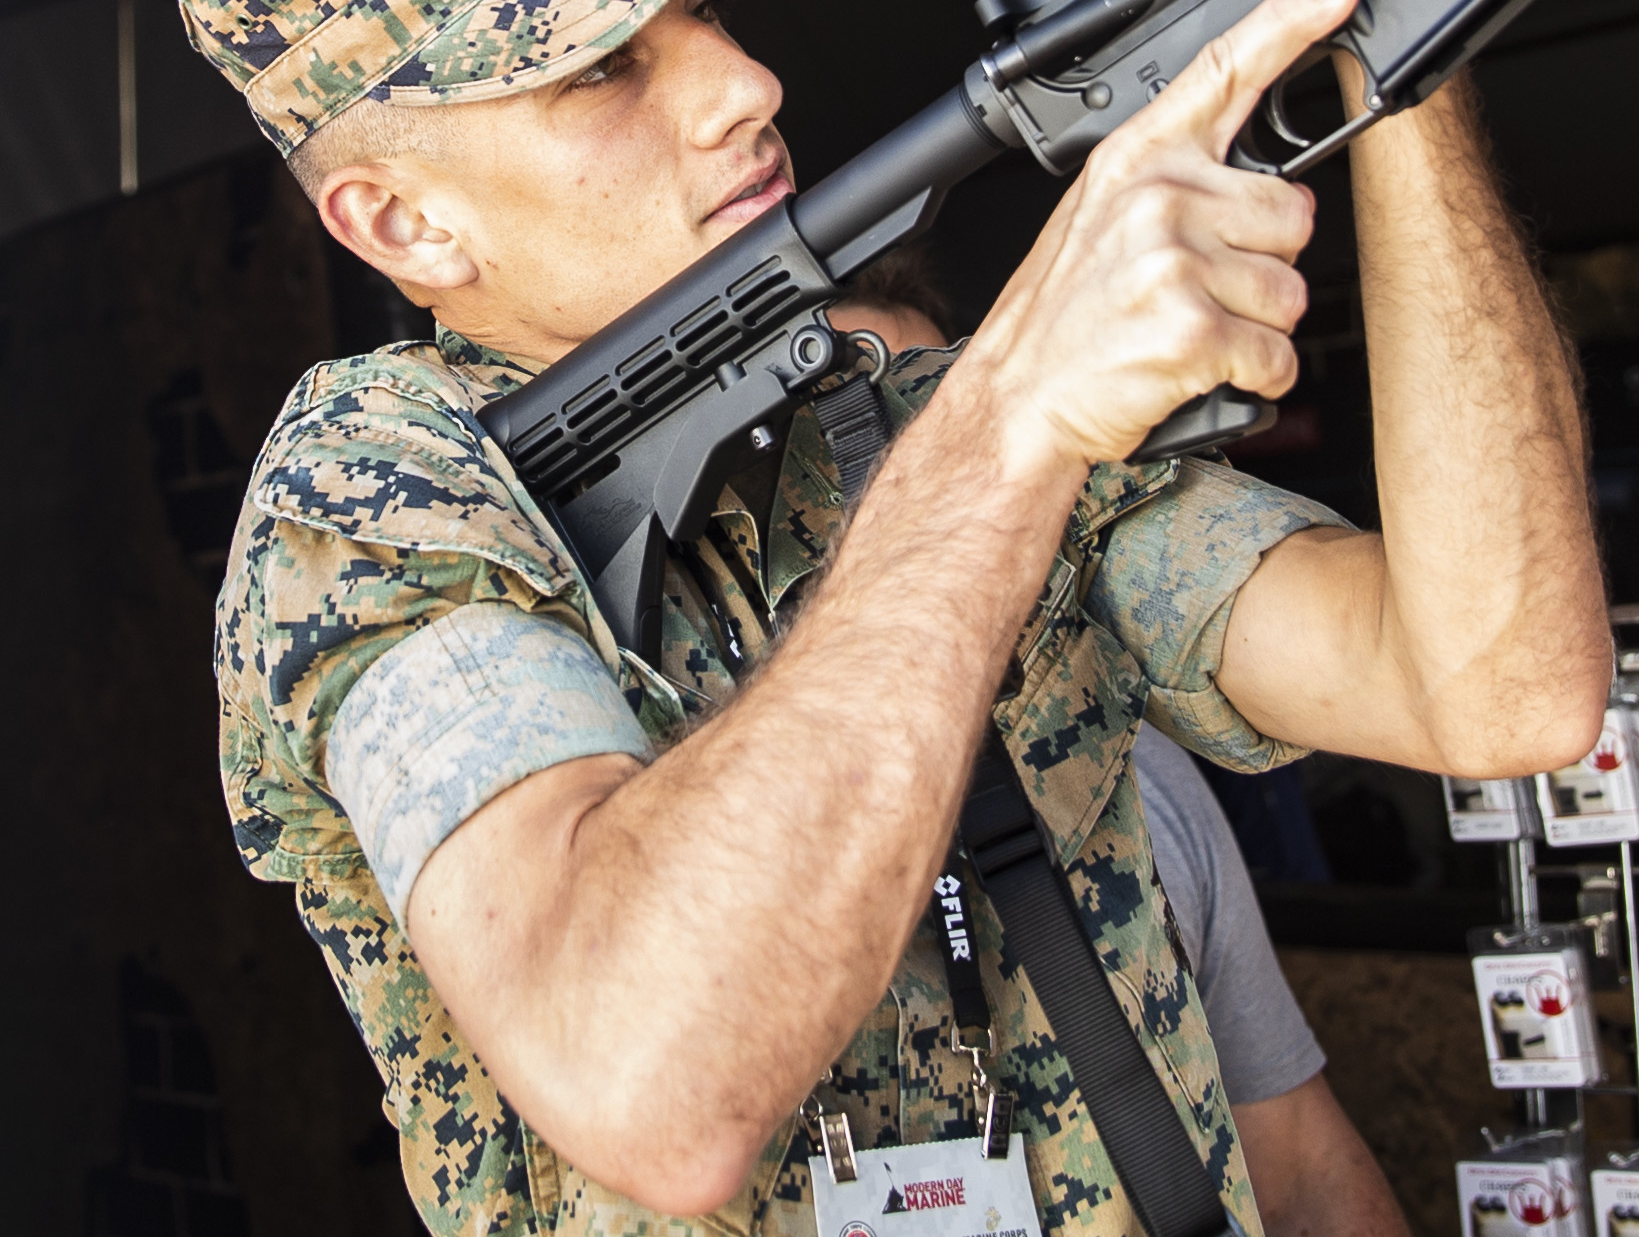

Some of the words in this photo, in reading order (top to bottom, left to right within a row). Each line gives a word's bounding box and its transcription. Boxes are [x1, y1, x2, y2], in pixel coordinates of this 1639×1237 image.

[941, 896, 970, 962] FLIR
[904, 1180, 944, 1194] MODERN
[946, 1177, 964, 1192] DAY
[905, 1189, 966, 1212] MARINE
